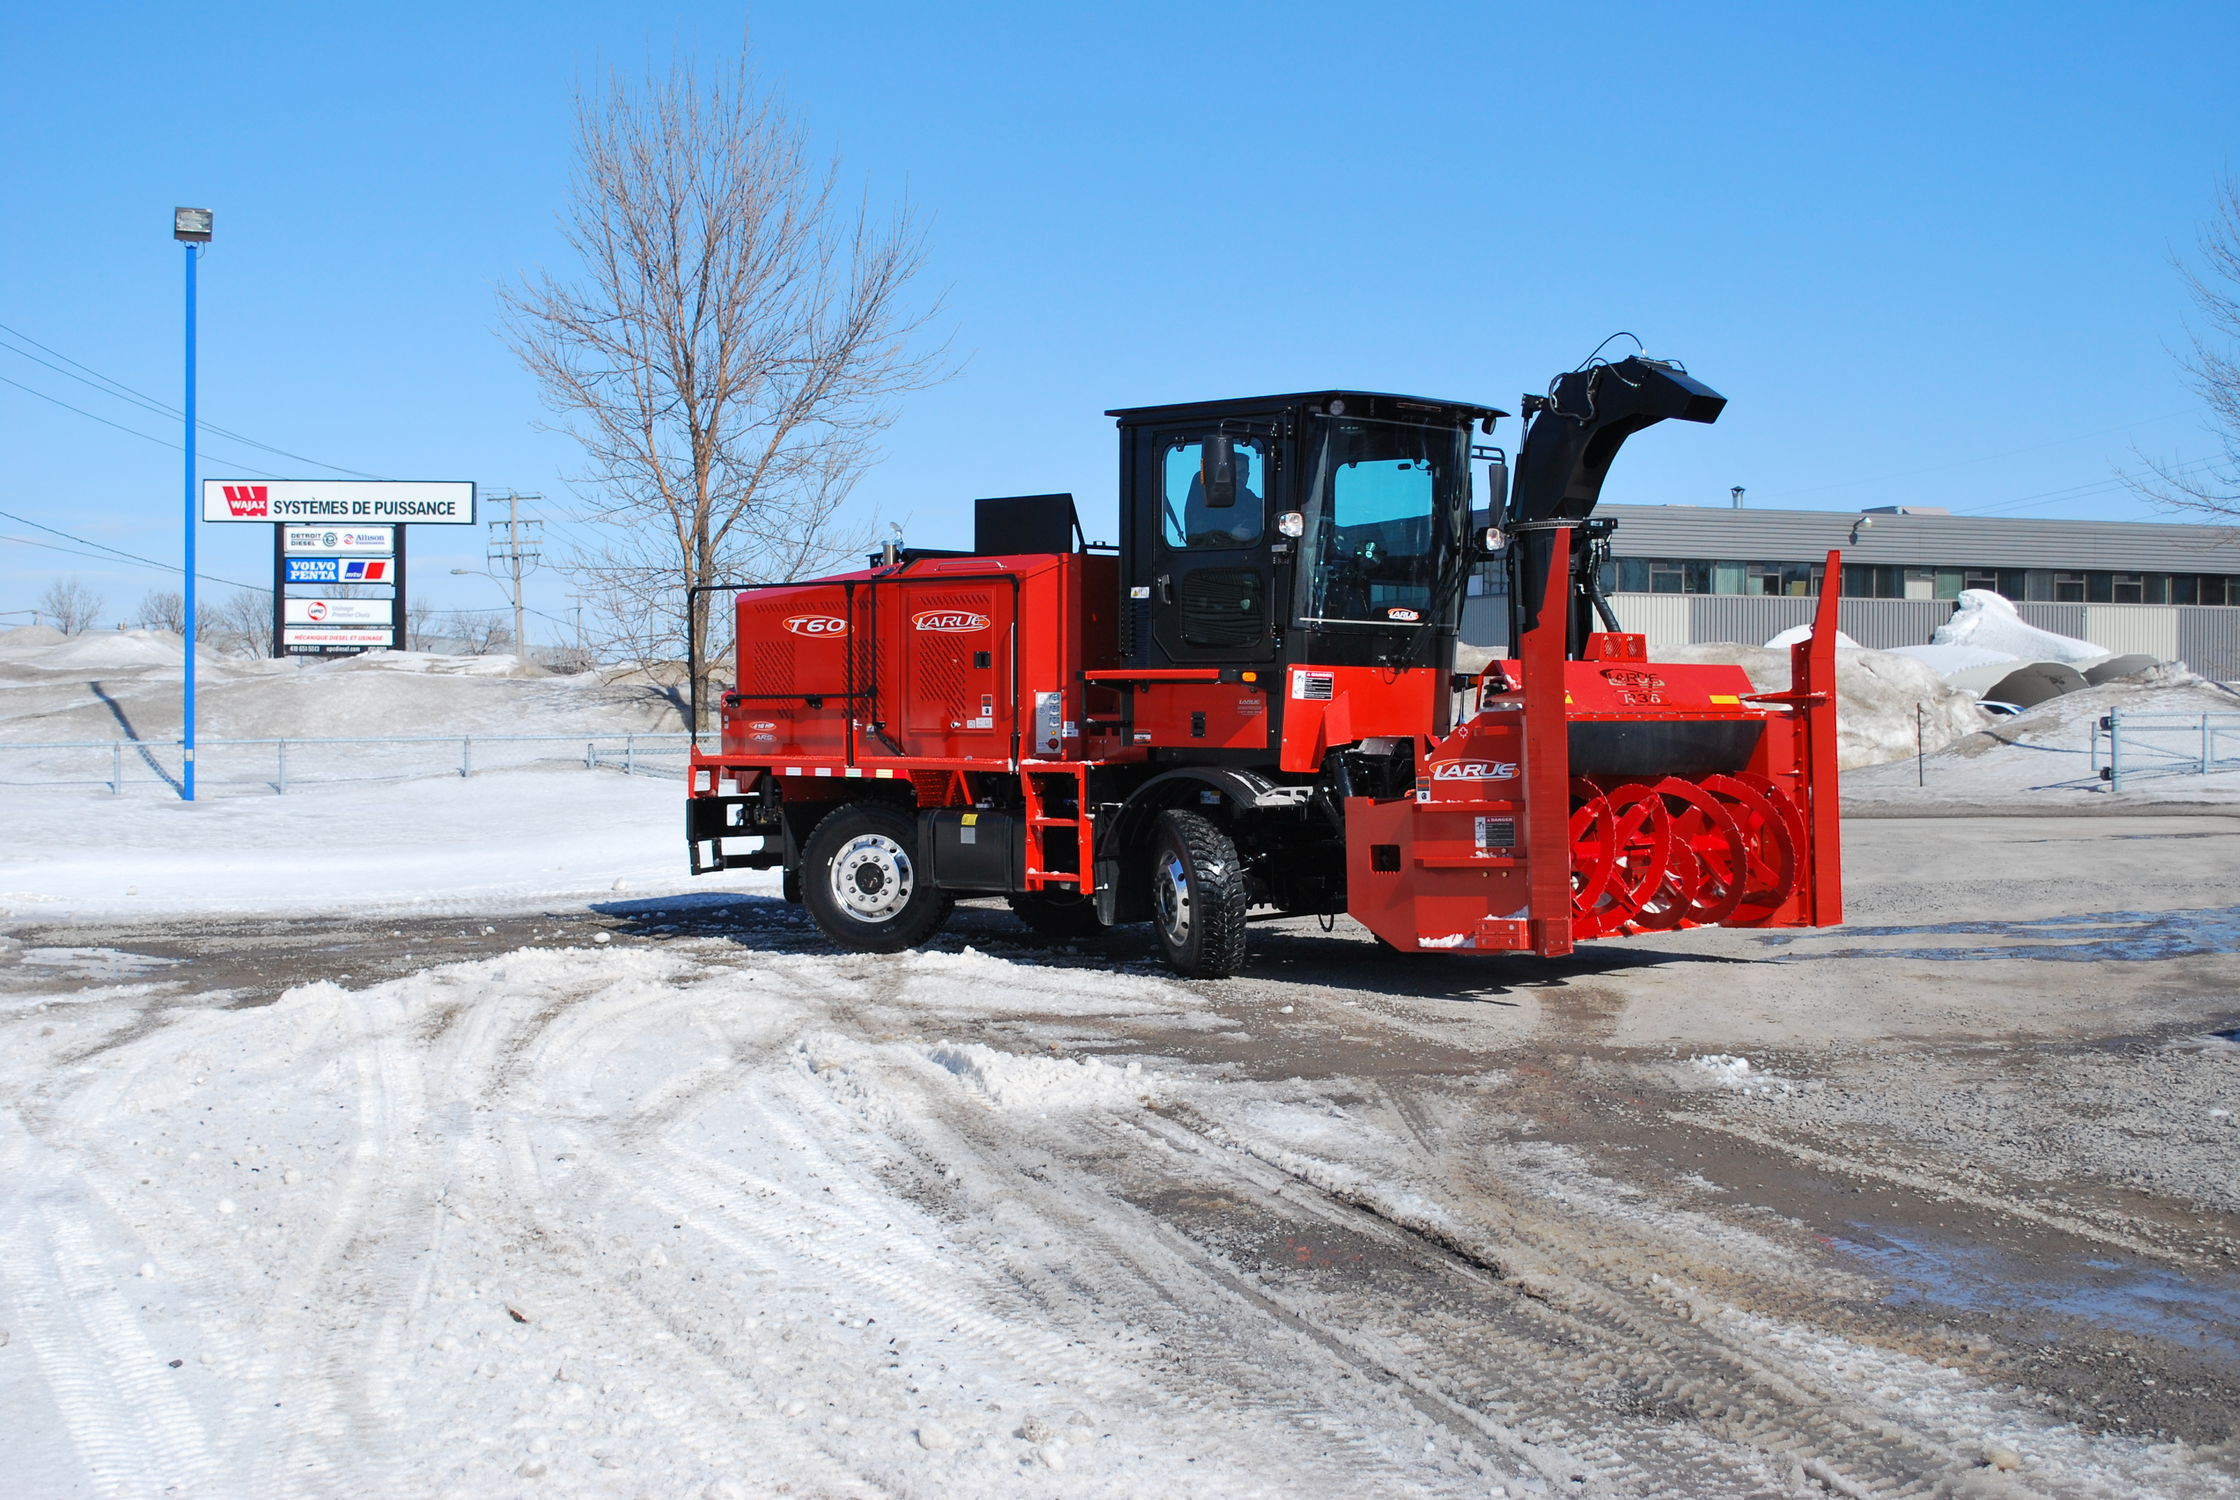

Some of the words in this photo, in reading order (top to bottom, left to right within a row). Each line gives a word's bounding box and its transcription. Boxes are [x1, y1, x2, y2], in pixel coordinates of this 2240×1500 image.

[230, 500, 266, 511] WAJAX
[273, 497, 348, 514] SYSTÈMES
[352, 501, 371, 515] DE
[374, 501, 456, 515] PUISSANCE
[290, 561, 336, 570] VOLVO
[290, 570, 336, 580] PENTA
[1388, 610, 1419, 620] LARUE
[788, 618, 846, 633] T60
[916, 614, 988, 631] LARUE
[1624, 693, 1661, 704] R36
[1433, 762, 1517, 780] LARUE
